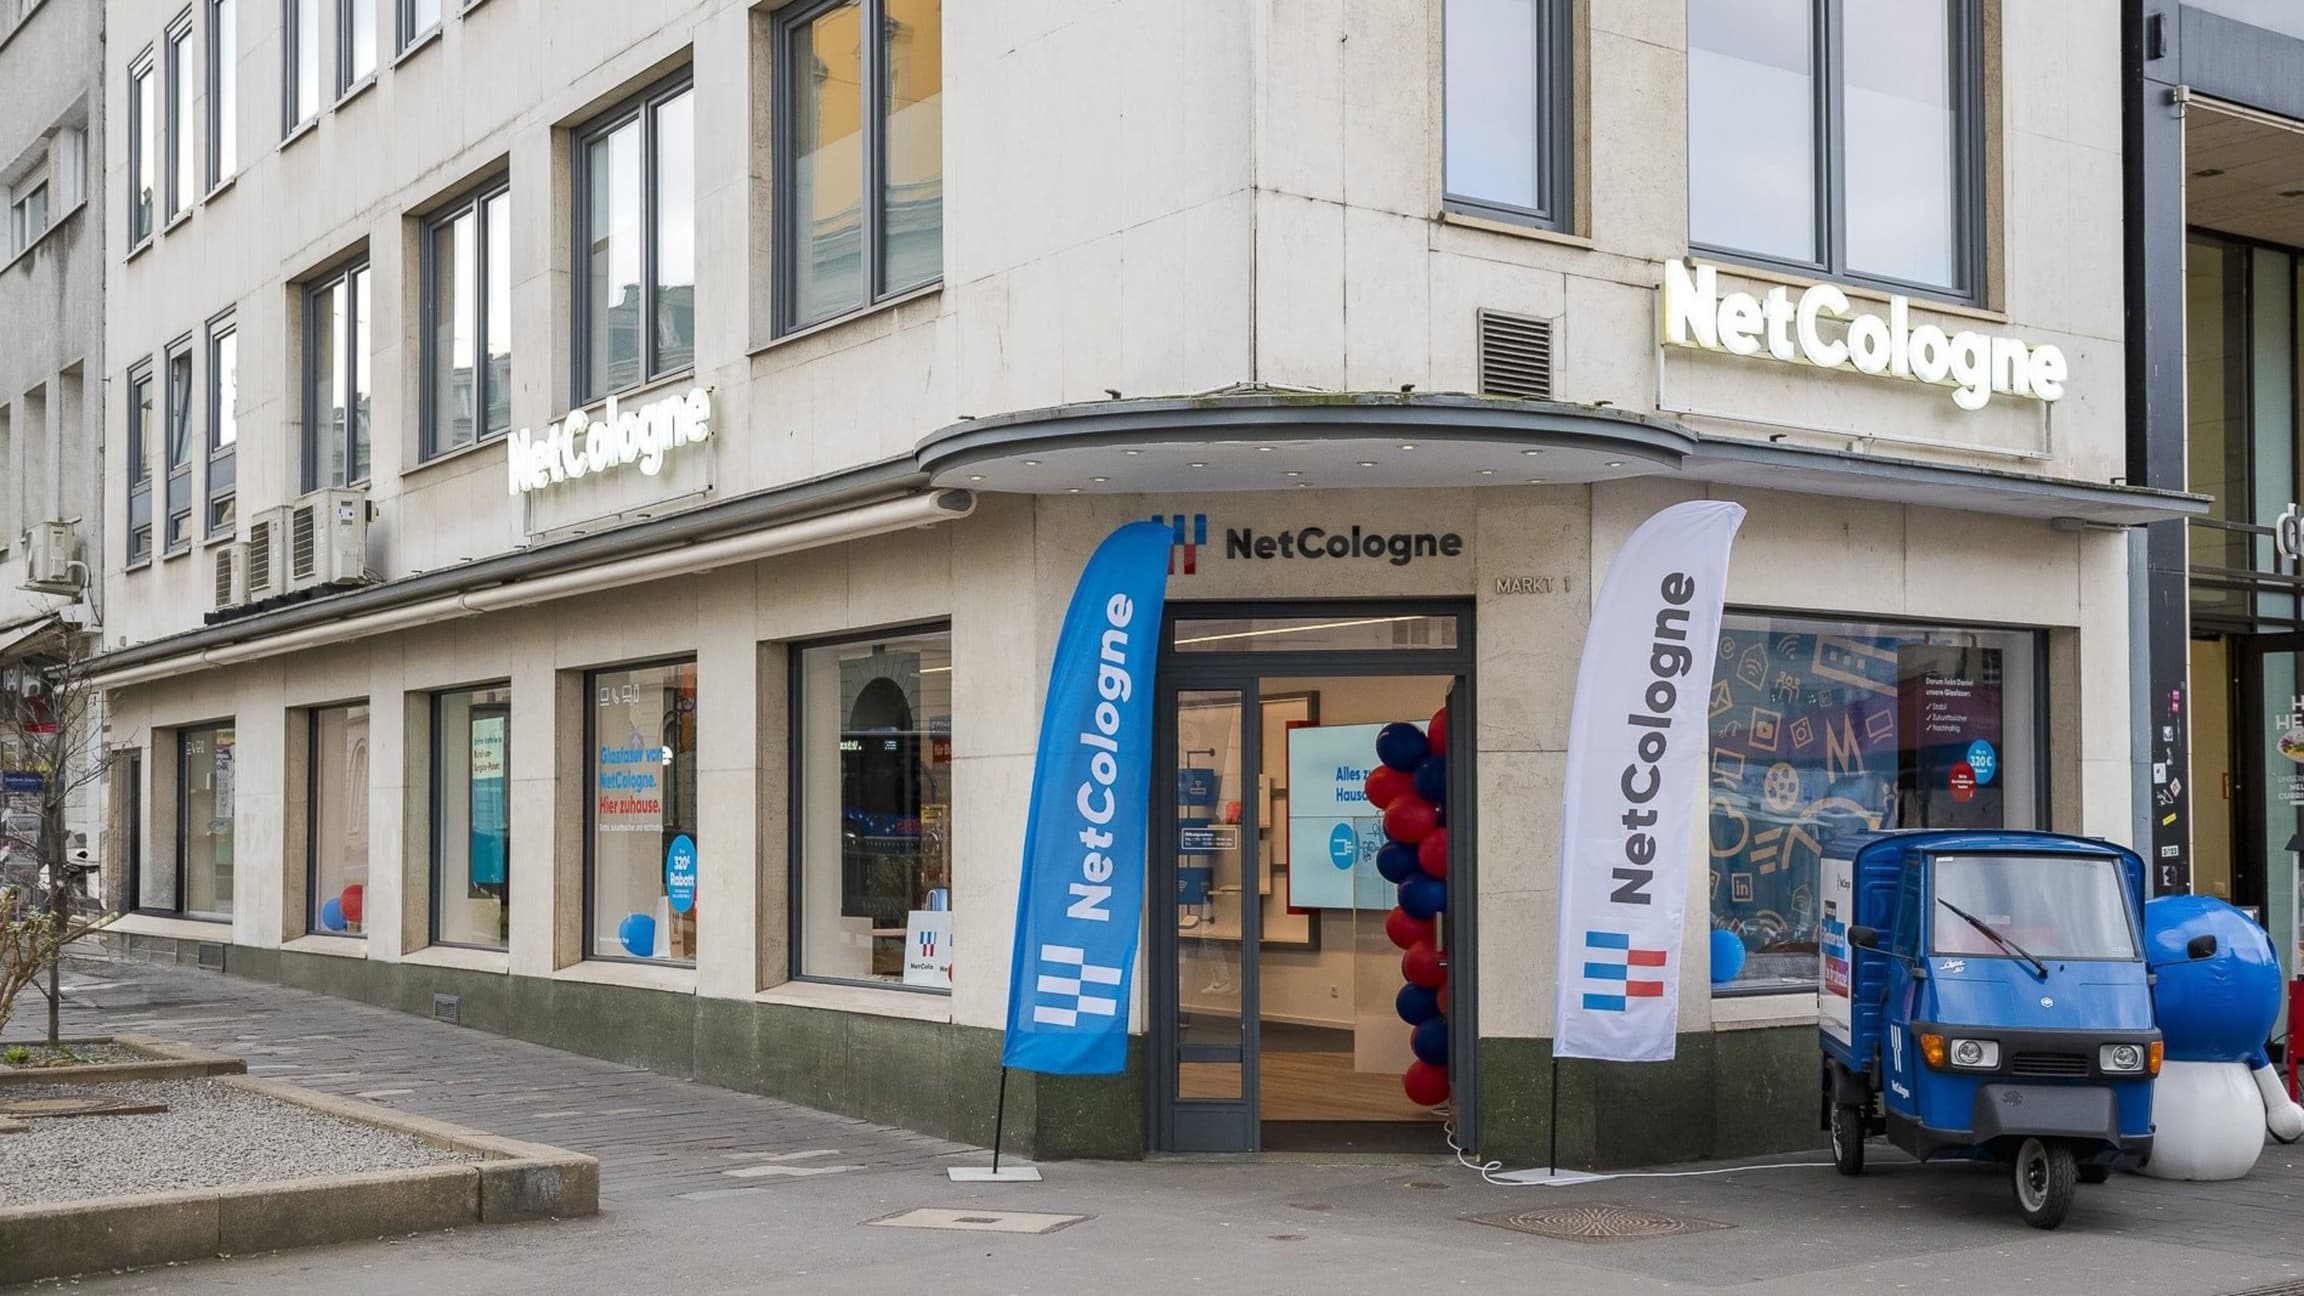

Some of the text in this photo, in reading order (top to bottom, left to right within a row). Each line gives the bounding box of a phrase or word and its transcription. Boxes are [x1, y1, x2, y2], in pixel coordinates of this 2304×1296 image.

[1664, 259, 2068, 410] NetCologne
[508, 387, 710, 496] NetCologne
[1226, 525, 1464, 567] NetCologne
[1496, 576, 1553, 594] MARKT
[1066, 593, 1134, 923] NetCologne
[1610, 572, 1696, 906] NetCologne
[1336, 766, 1360, 781] Alles
[600, 795, 661, 815] Hier zuhause.
[670, 872, 695, 887] Rabatt
